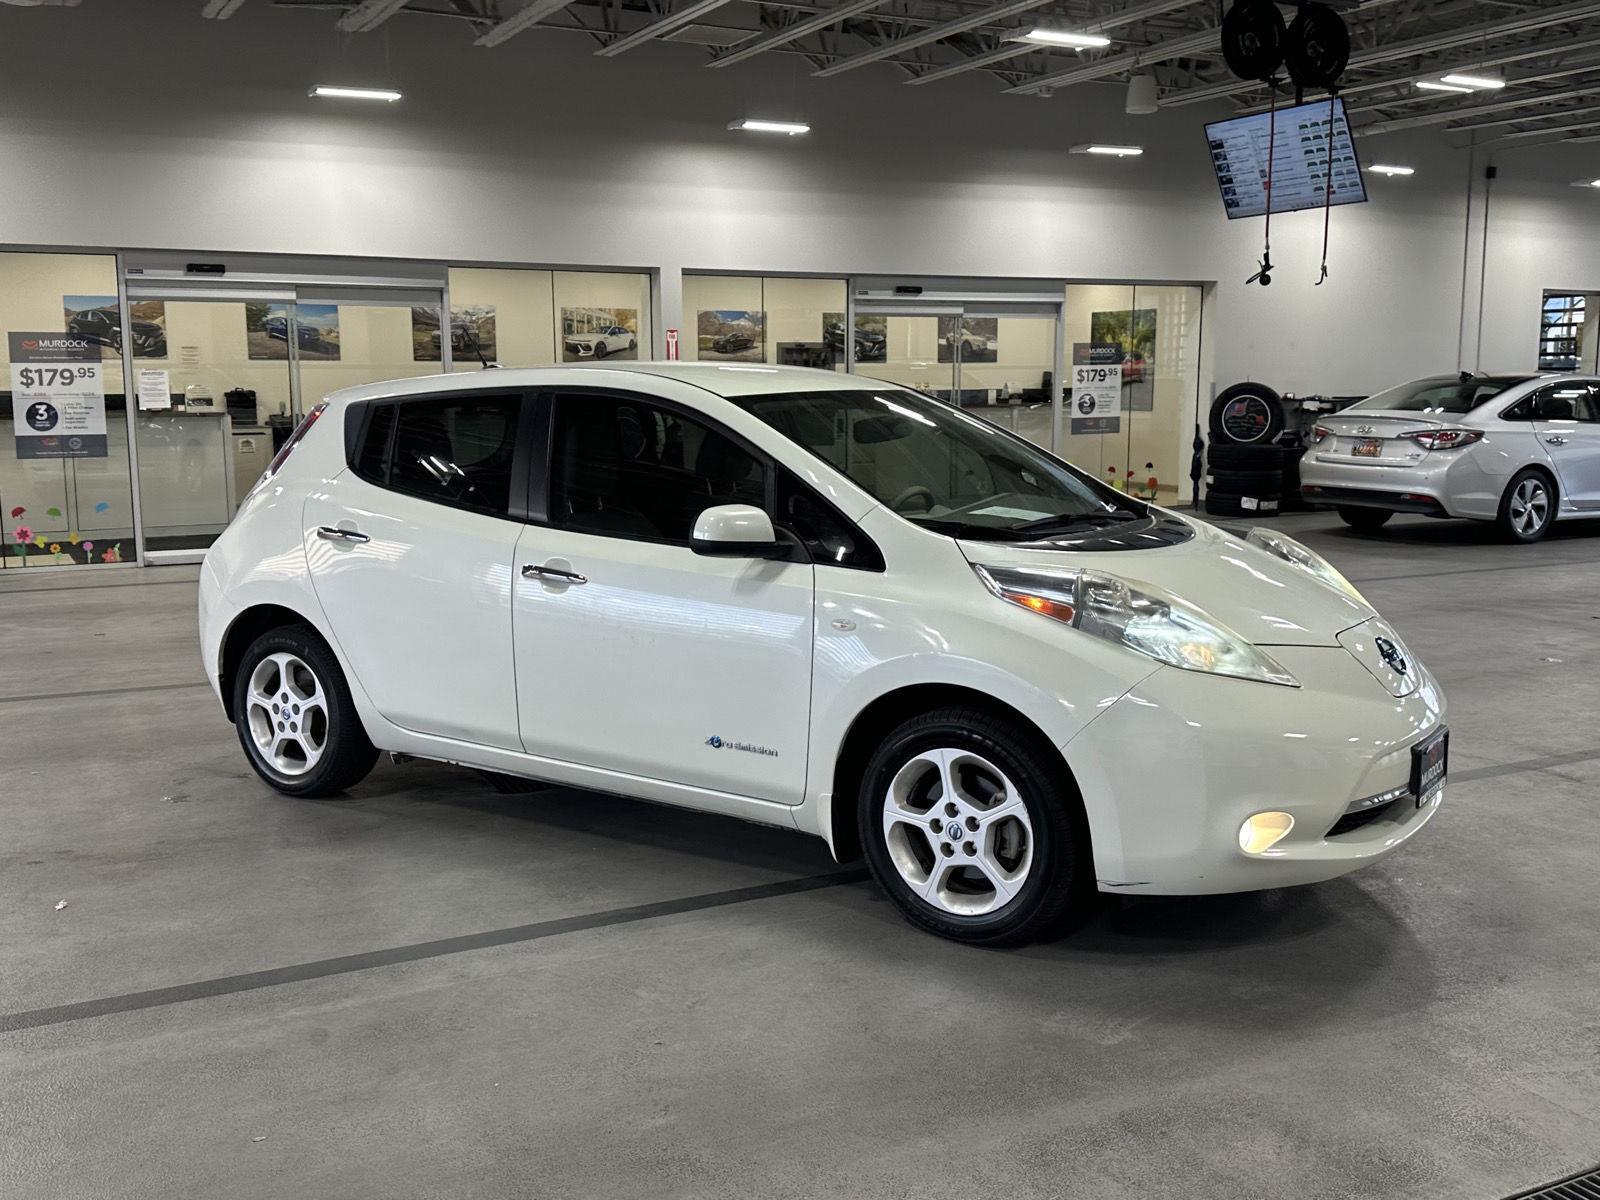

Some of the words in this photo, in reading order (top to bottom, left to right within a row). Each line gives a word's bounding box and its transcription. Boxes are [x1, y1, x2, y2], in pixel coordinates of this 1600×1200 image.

[39, 339, 88, 348] MURDOCK
[20, 367, 95, 388] $179.95
[1077, 368, 1118, 383] $179.95
[35, 404, 48, 421] 3
